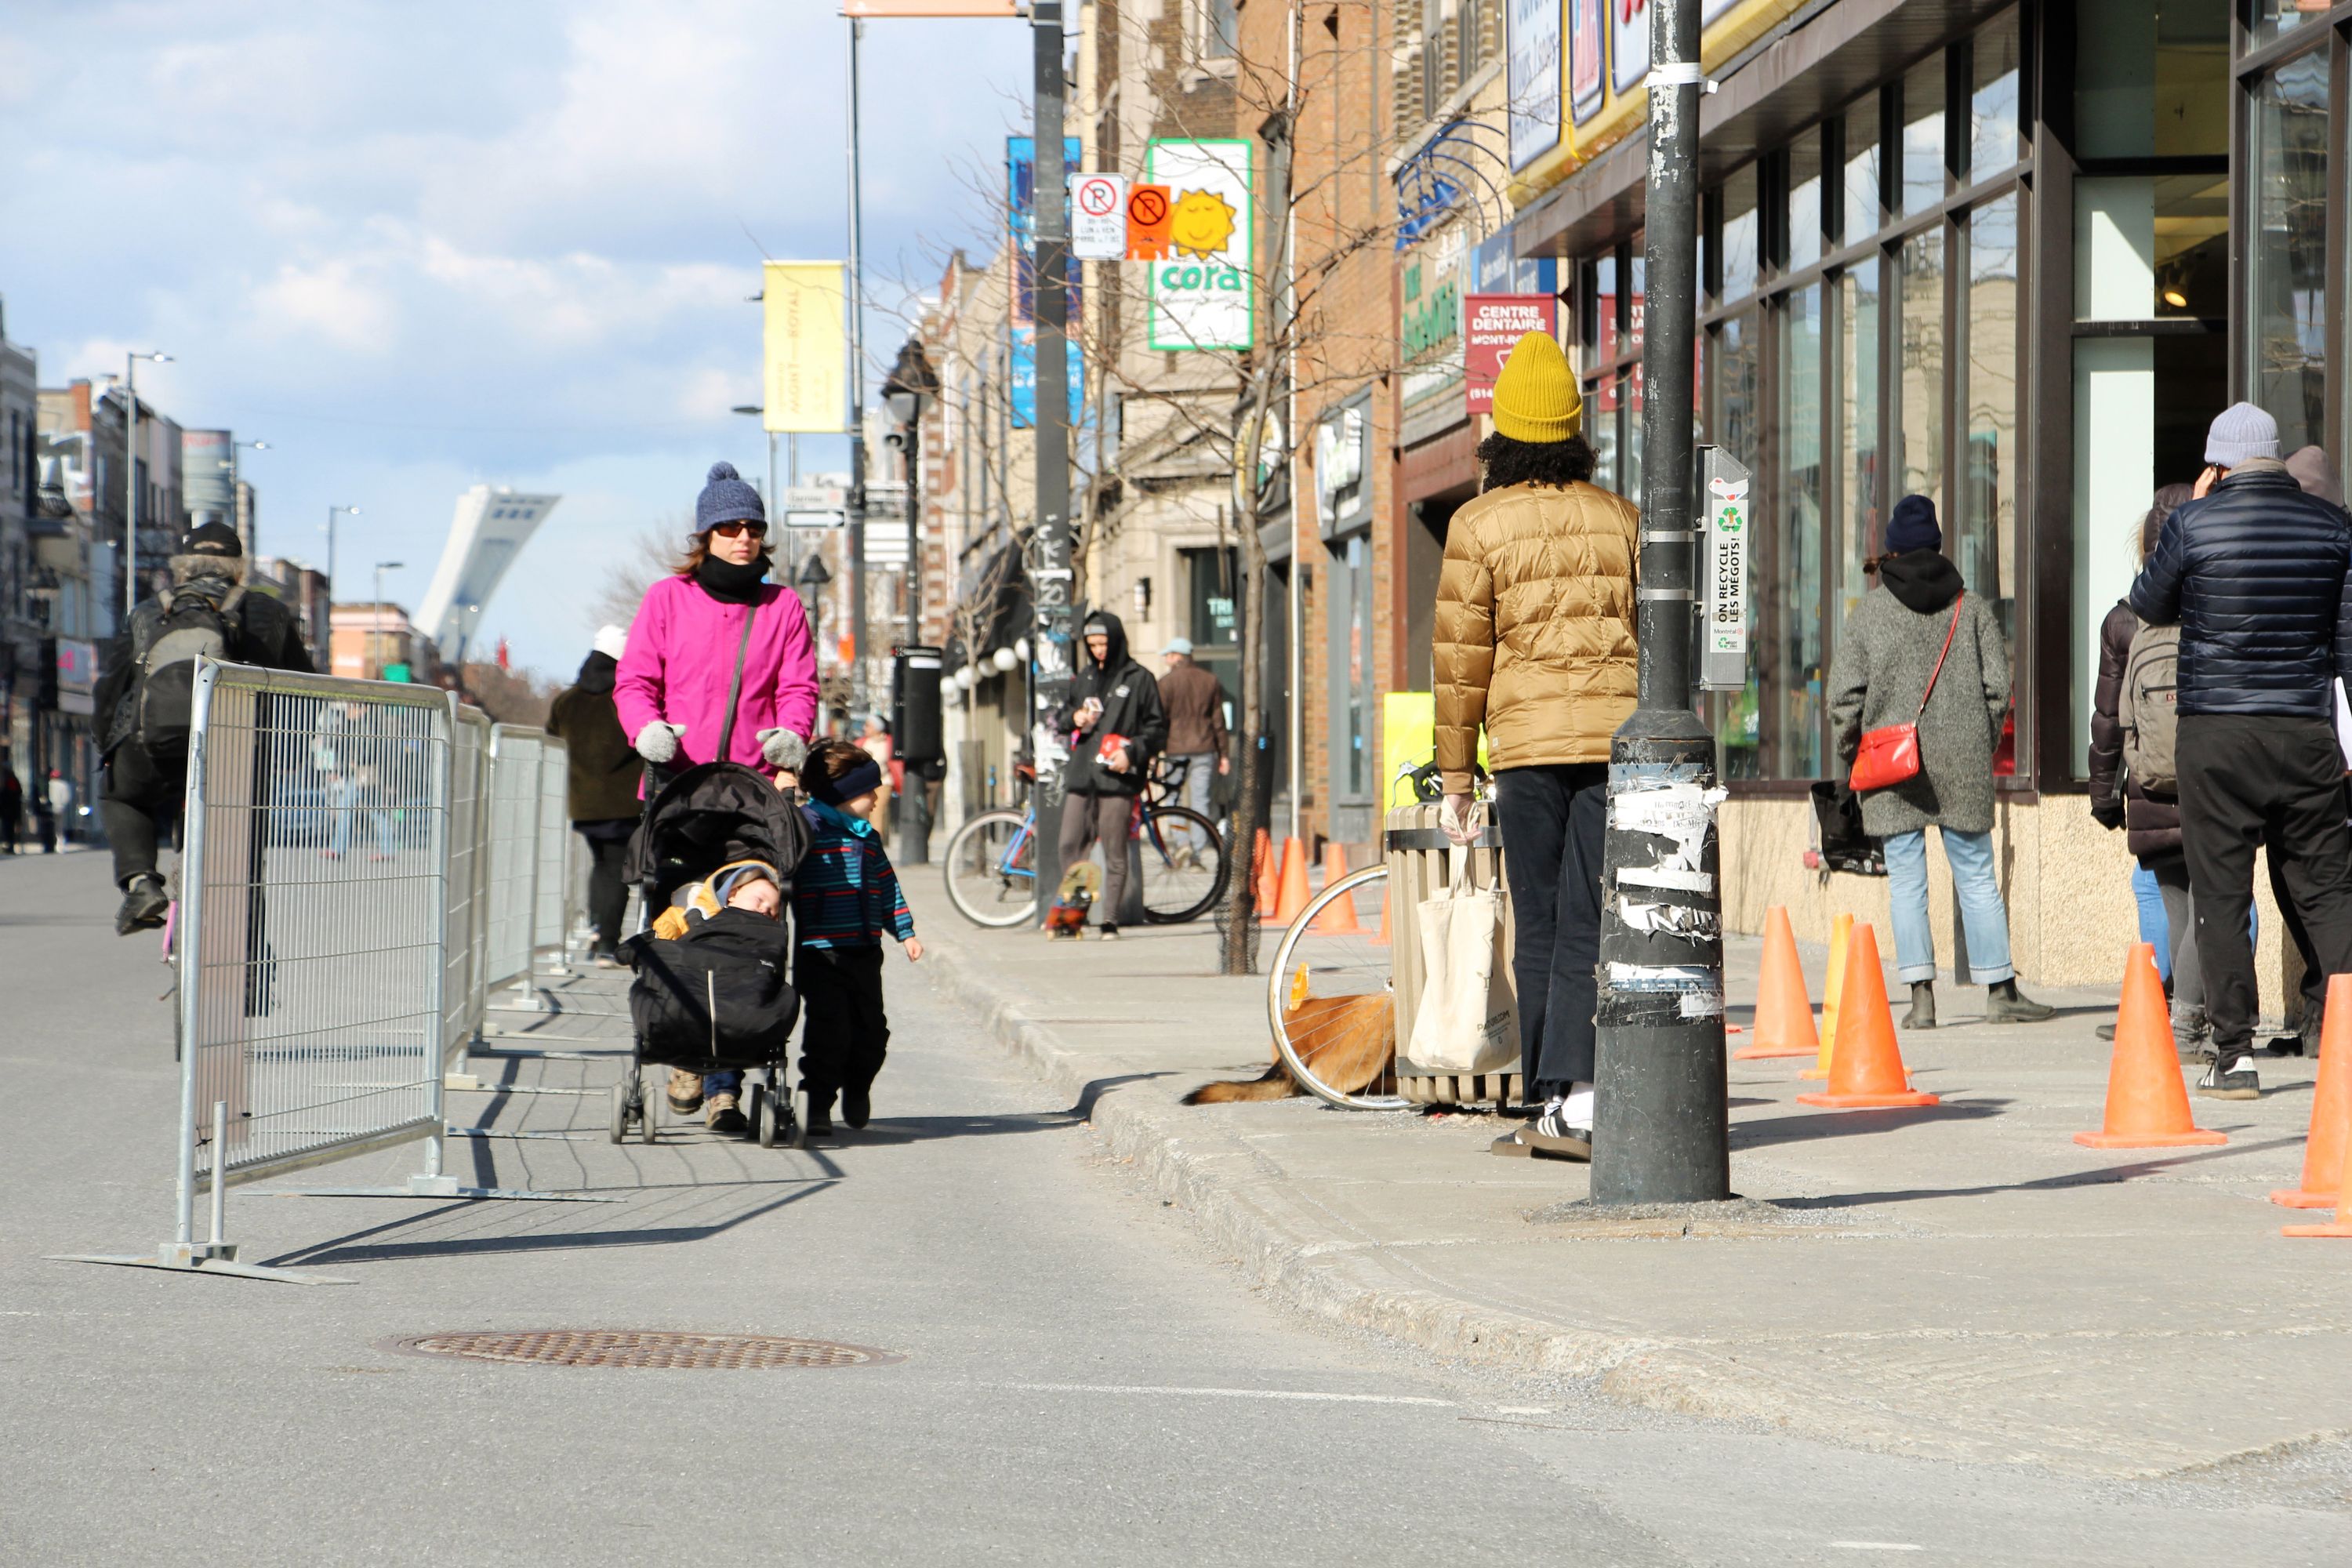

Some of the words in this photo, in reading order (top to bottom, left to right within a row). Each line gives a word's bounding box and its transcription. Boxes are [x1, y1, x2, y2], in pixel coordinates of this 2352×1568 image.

[1161, 266, 1242, 291] cora
[1479, 306, 1540, 318] CENTRE
[1472, 318, 1546, 331] DENTAIRE
[1472, 335, 1522, 345] MONT-RO
[1469, 388, 1493, 400] (514
[1719, 543, 1728, 599] RECYCLE
[1728, 538, 1740, 596] MÉGOTS!
[1719, 604, 1728, 622] ON
[1730, 601, 1739, 622] LES
